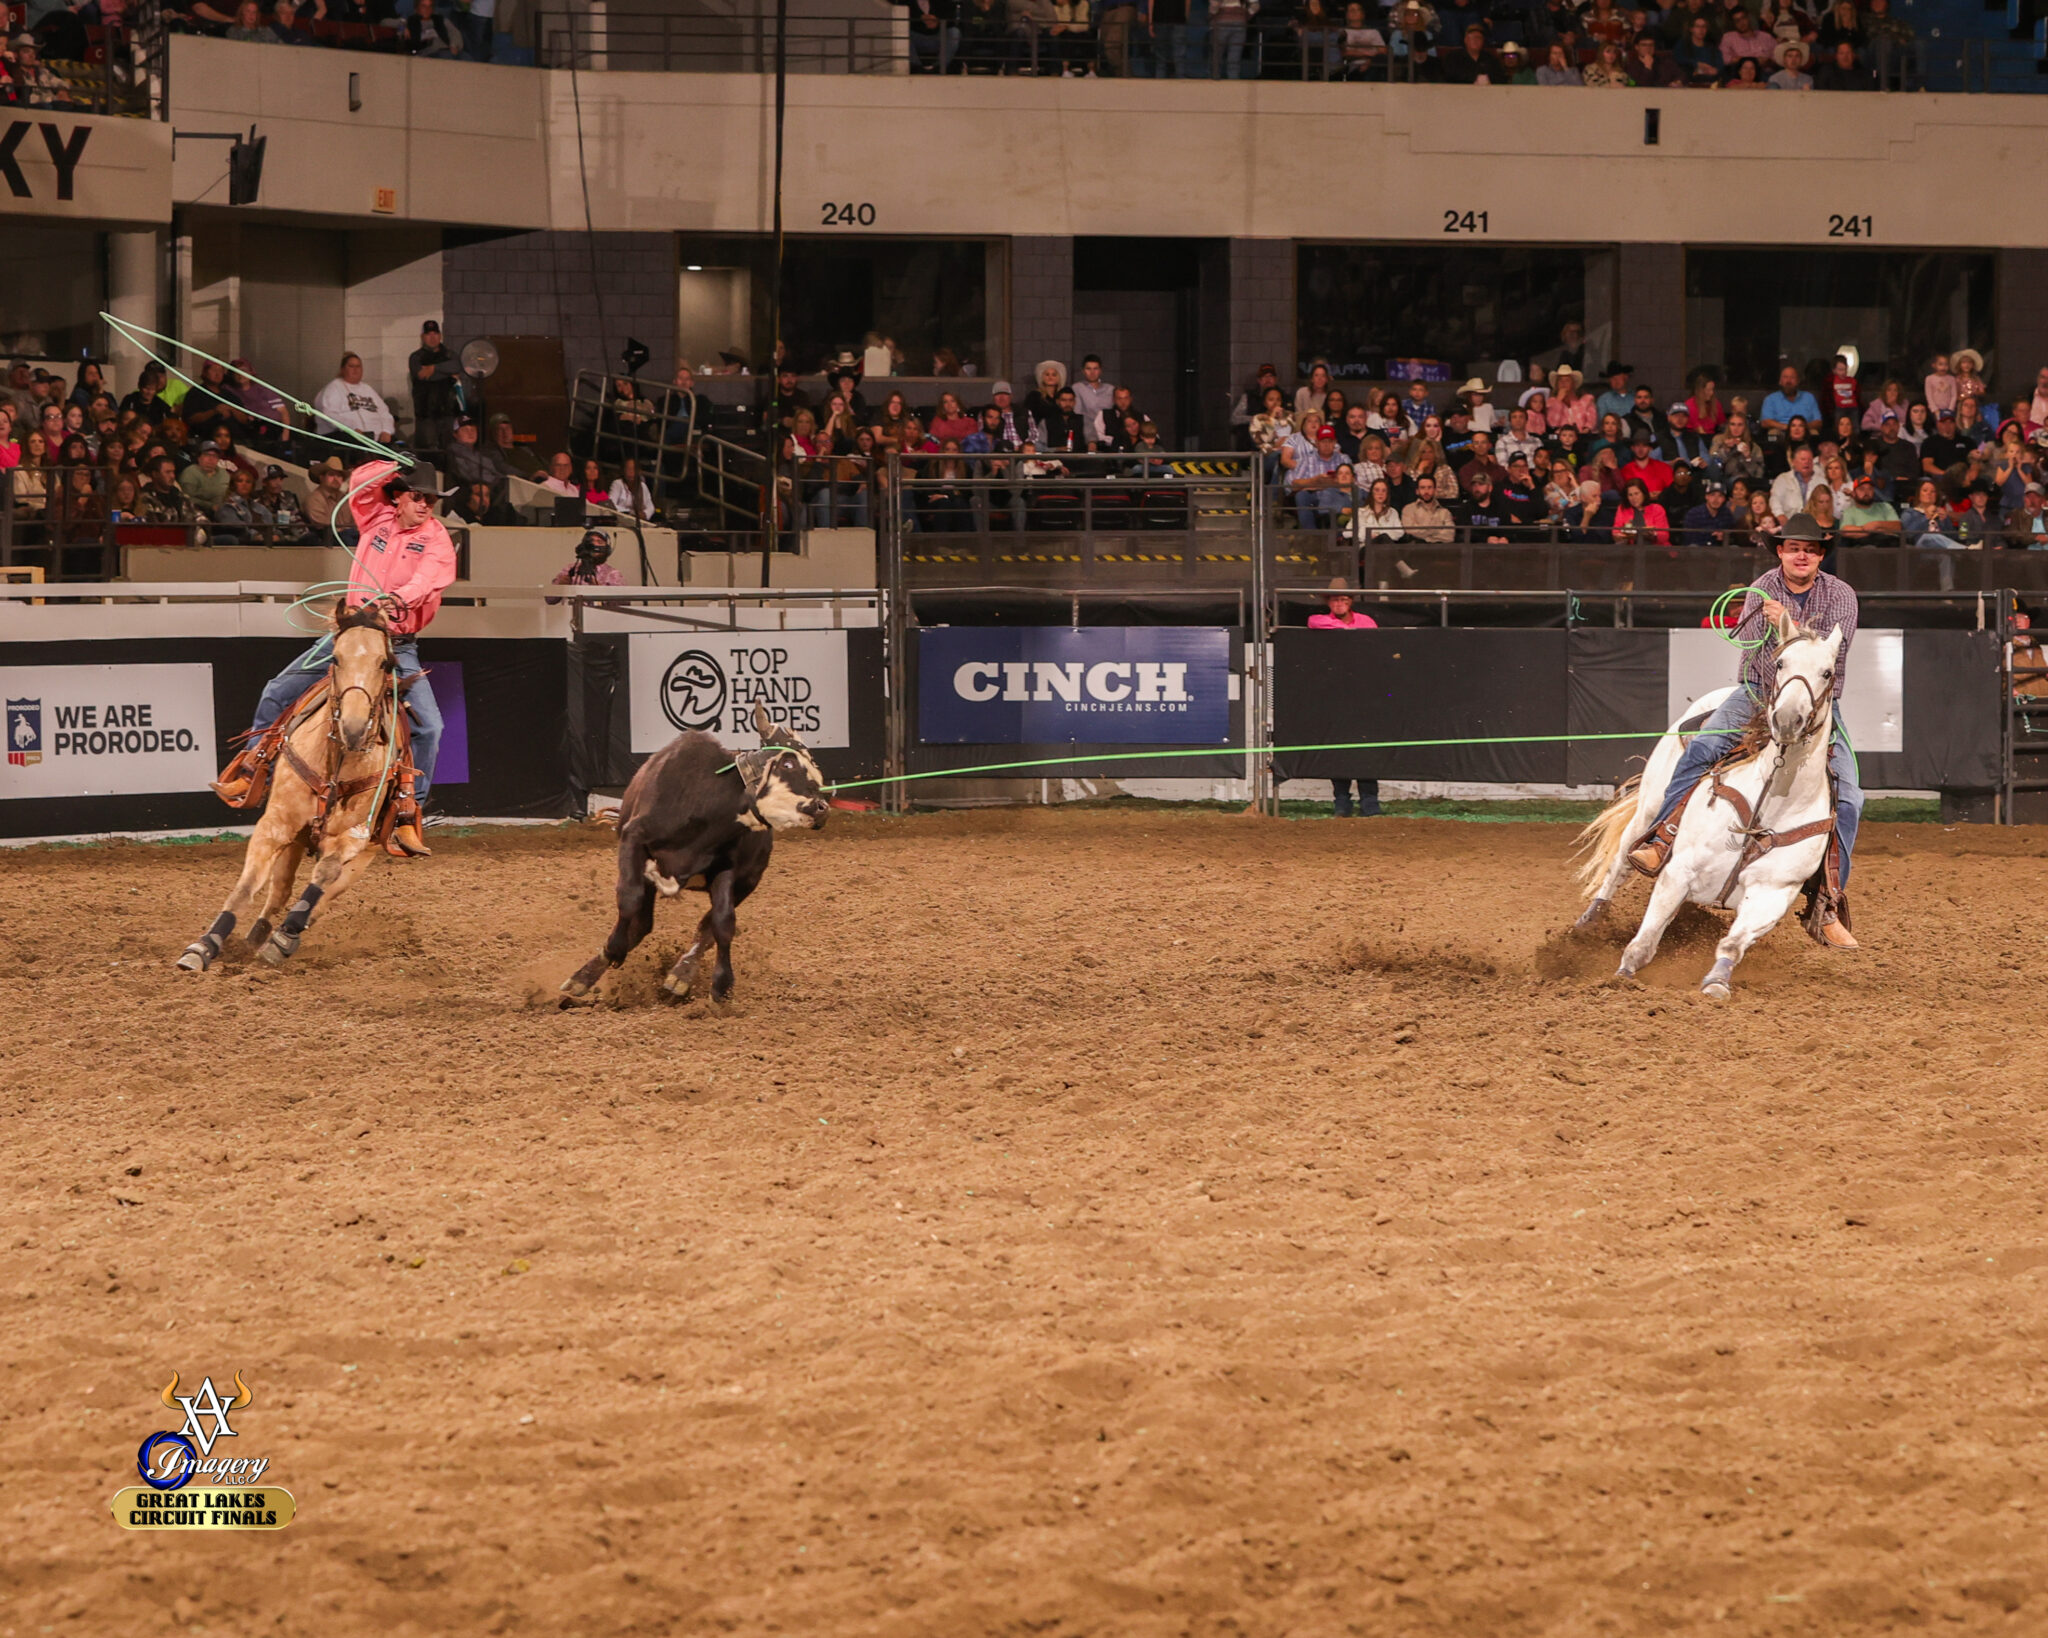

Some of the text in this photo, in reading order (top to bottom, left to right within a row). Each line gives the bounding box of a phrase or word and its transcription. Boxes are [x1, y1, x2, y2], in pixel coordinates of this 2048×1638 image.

[0, 121, 93, 201] KY
[821, 202, 876, 226] 240
[1443, 209, 1488, 233] 241
[1828, 214, 1872, 237] 241
[730, 648, 788, 675] TOP
[731, 677, 811, 704] HAND
[953, 661, 1188, 701] CINCH
[54, 704, 152, 729] WE ARE
[731, 705, 820, 734] ROPES
[1065, 703, 1187, 712] CINCHJEANS.COM
[54, 728, 200, 756] PRORODEO.
